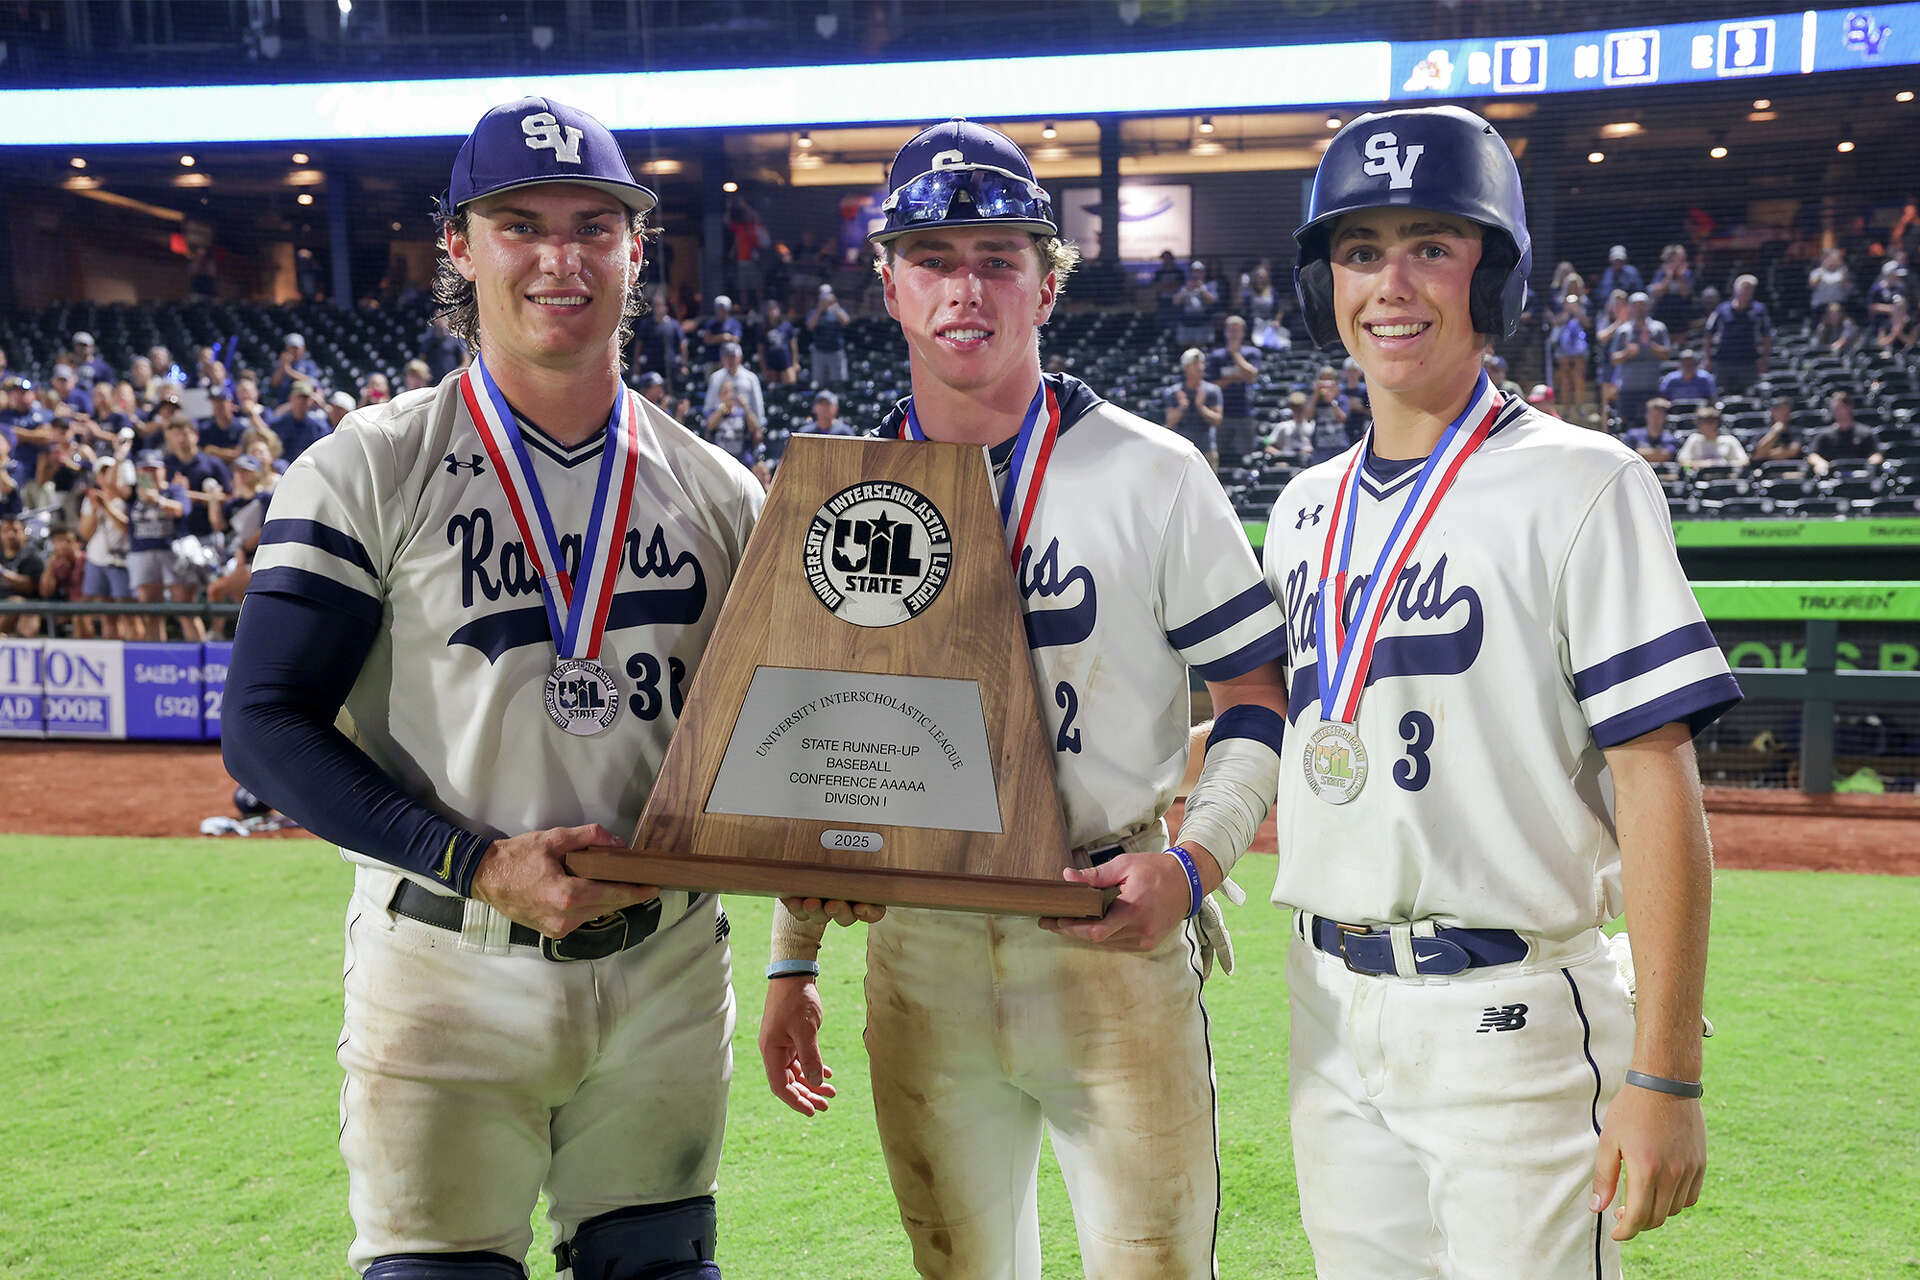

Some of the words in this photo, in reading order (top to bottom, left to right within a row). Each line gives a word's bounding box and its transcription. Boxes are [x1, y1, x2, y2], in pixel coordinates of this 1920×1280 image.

[521, 112, 583, 164] SV
[1363, 131, 1424, 190] SV
[446, 508, 707, 615] Ragrs
[806, 521, 842, 608] UNIVERSITY
[829, 484, 947, 542] INTERSCHOLASTIC
[907, 556, 948, 611] LEAGUE
[832, 518, 921, 577] UIL
[845, 575, 902, 594] STATE
[559, 675, 604, 708] UIL
[568, 709, 598, 719] STATE
[756, 701, 817, 757] UNIVERSITY
[820, 690, 931, 728] INTERSCHOLASTIC
[928, 724, 964, 770] LEAGUE
[1055, 681, 1081, 754] 2
[801, 738, 839, 751] STATE
[843, 741, 920, 756] RUNNER-UP
[826, 757, 891, 772] BASEBALL
[1393, 710, 1434, 791] 3
[789, 772, 877, 789] CONFERENCE
[880, 779, 926, 792] AAAAA
[825, 792, 880, 806] DIVISION
[834, 834, 870, 848] 2025
